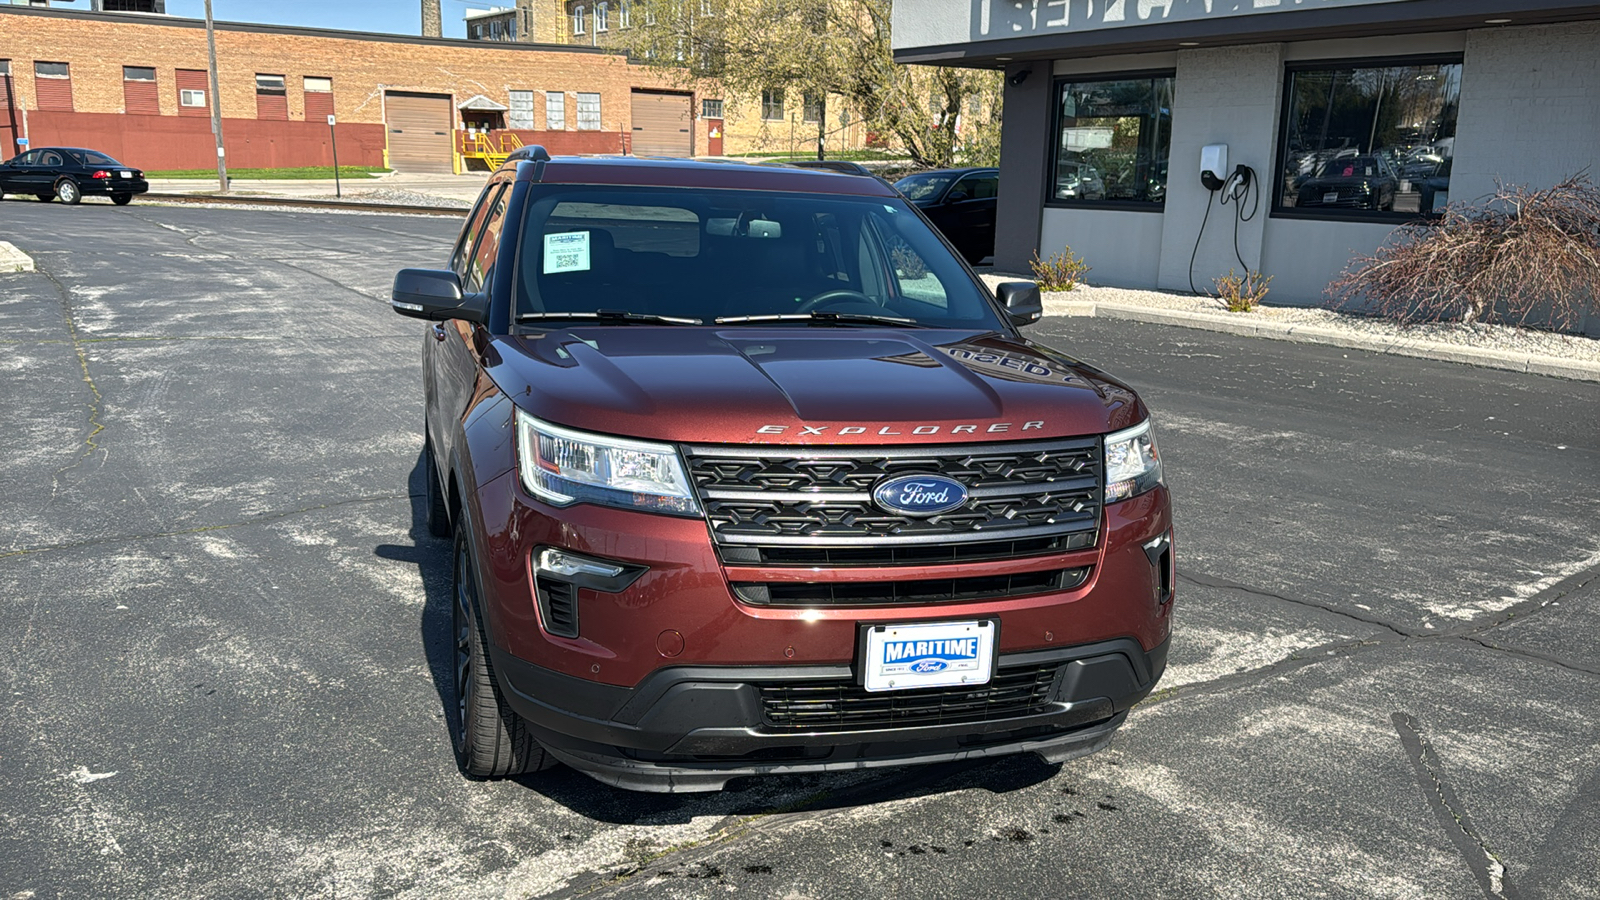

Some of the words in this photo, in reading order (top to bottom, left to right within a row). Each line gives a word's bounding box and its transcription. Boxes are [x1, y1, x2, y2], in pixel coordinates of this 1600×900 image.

[756, 420, 1045, 436] EXPLORER
[900, 482, 949, 504] Ford
[886, 639, 976, 662] MARITIME
[916, 661, 941, 672] Ford
